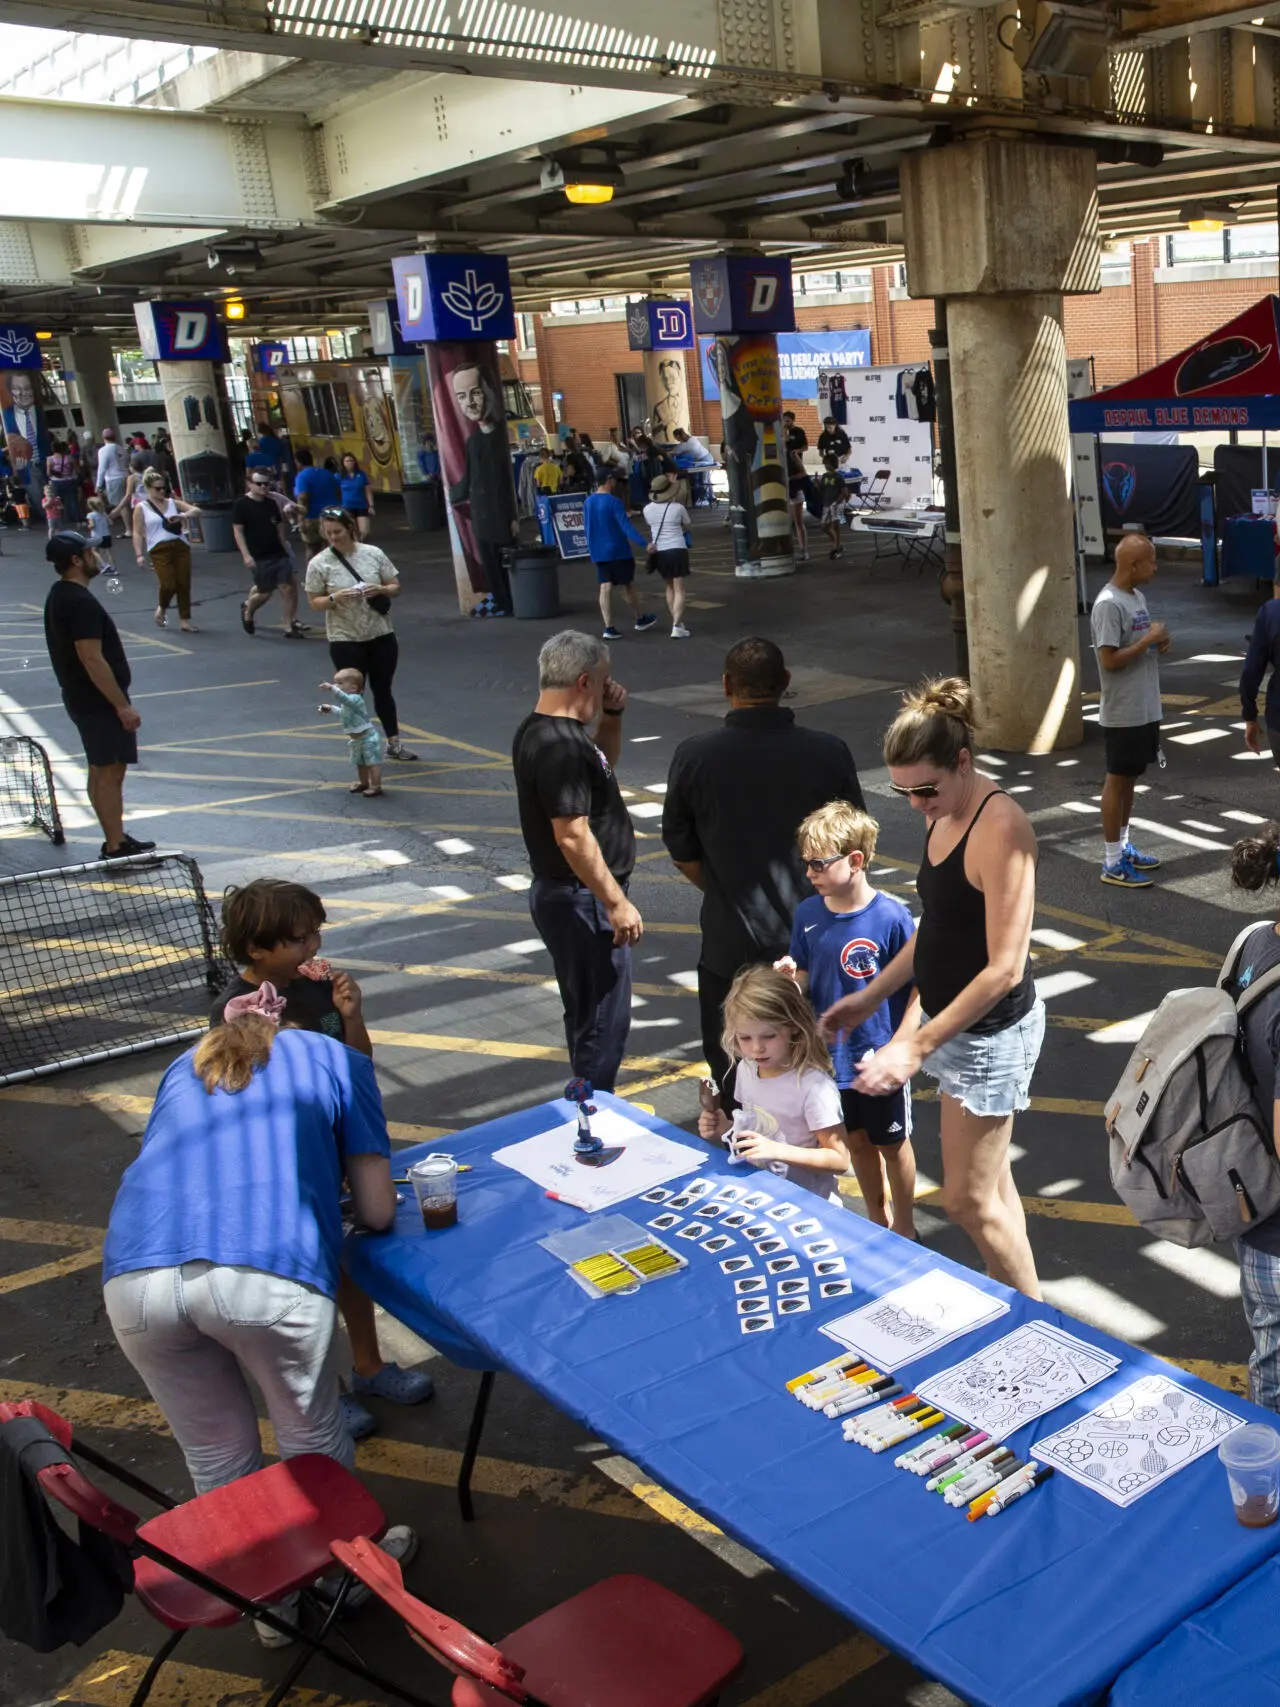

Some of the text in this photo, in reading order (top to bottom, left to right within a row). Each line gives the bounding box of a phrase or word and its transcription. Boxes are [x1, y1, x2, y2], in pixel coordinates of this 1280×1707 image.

[751, 274, 778, 313] D
[172, 310, 209, 351] D
[657, 308, 688, 341] D
[833, 351, 865, 366] PARTY
[1104, 406, 1249, 427] DEPAUL BLUE DEMONS
